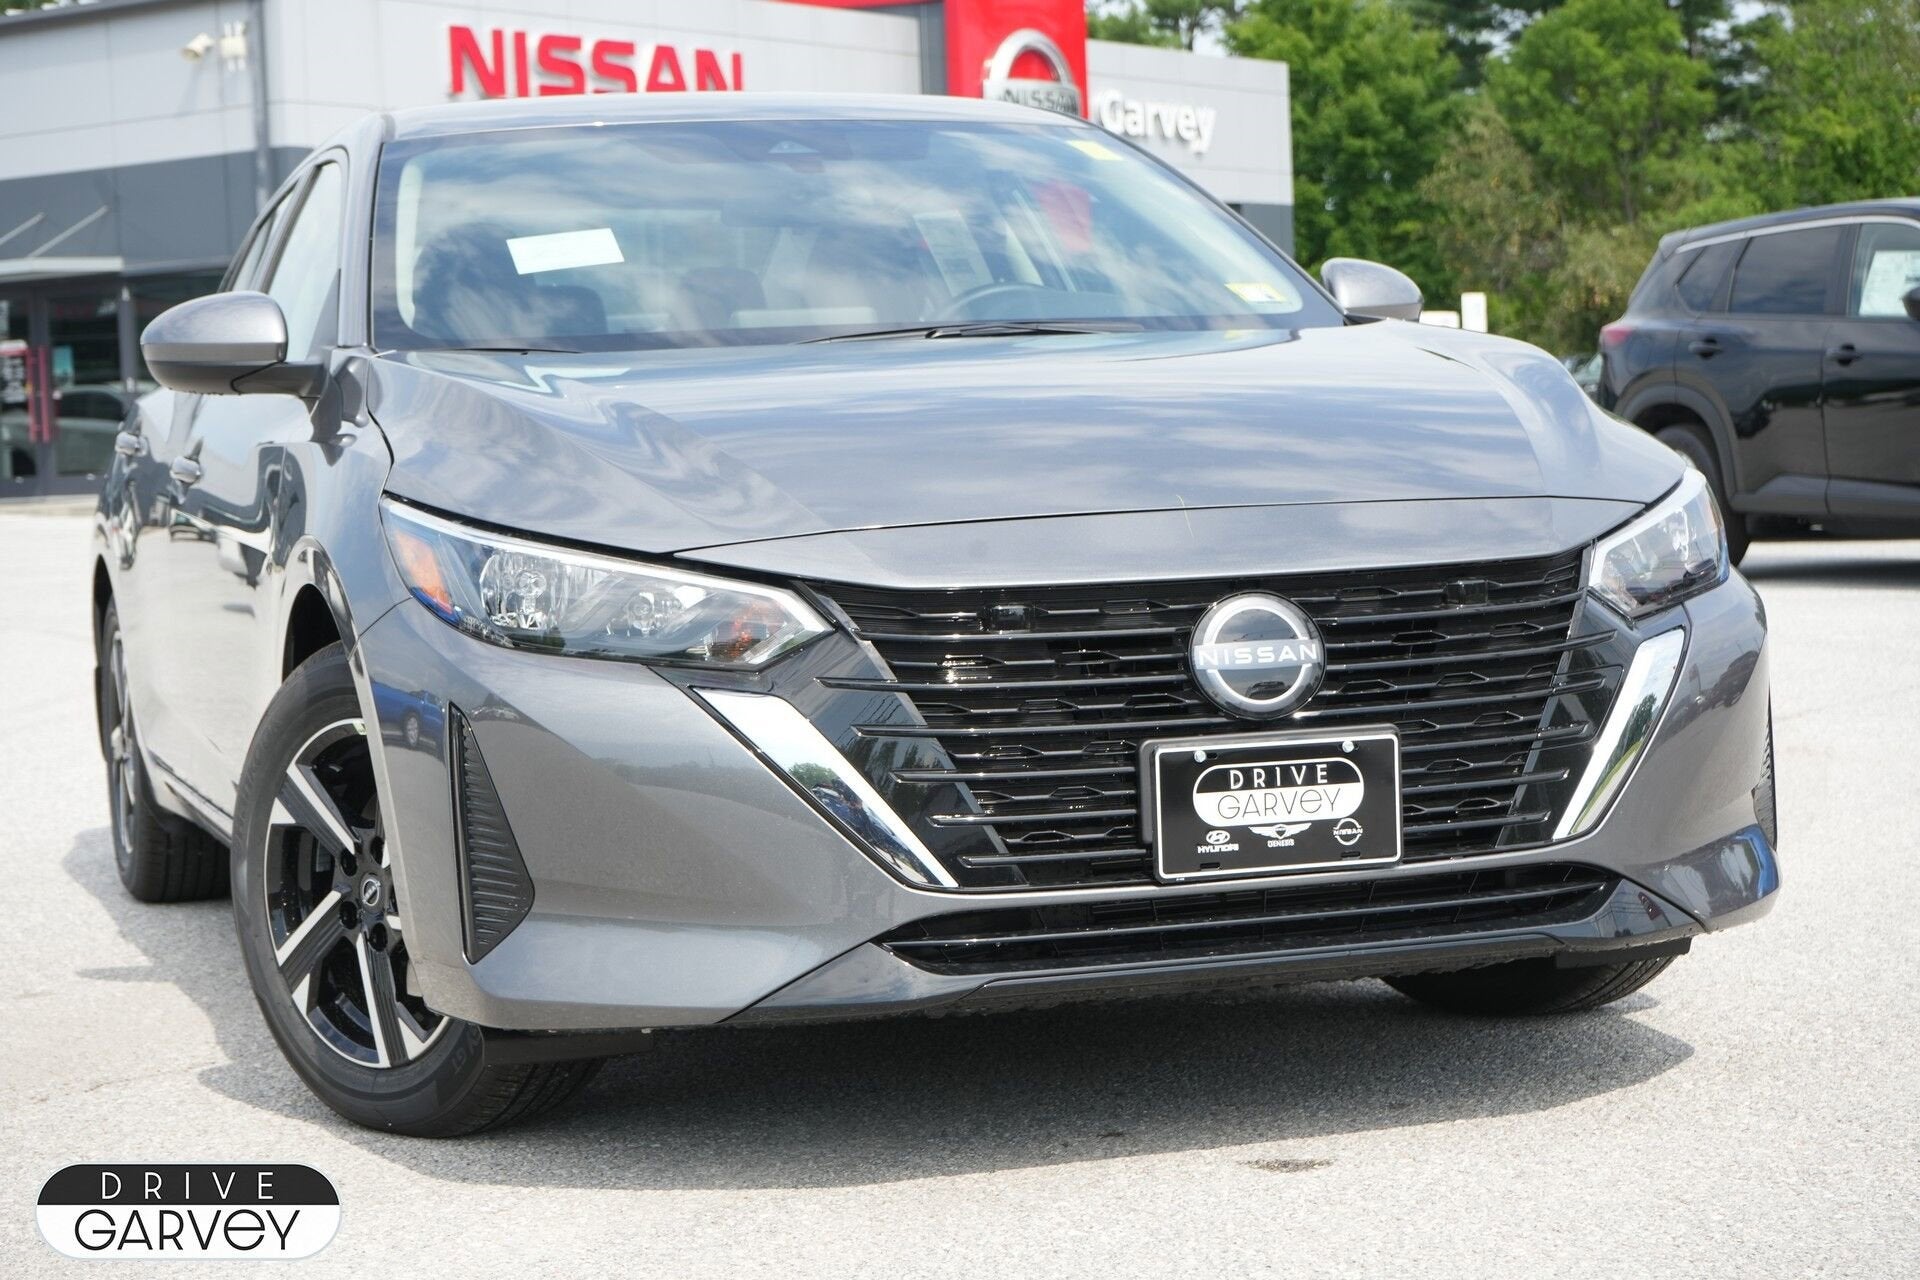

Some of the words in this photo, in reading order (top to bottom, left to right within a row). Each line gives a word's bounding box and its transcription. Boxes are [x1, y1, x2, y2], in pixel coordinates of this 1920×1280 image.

[449, 25, 742, 98] NISSAN
[1100, 88, 1216, 154] Garvey
[1198, 643, 1318, 667] NISSAN
[1229, 763, 1328, 790] DRIVE
[1267, 838, 1295, 848] GENESIS
[1333, 828, 1363, 836] NISSAN
[1197, 843, 1240, 854] HYUNDAI
